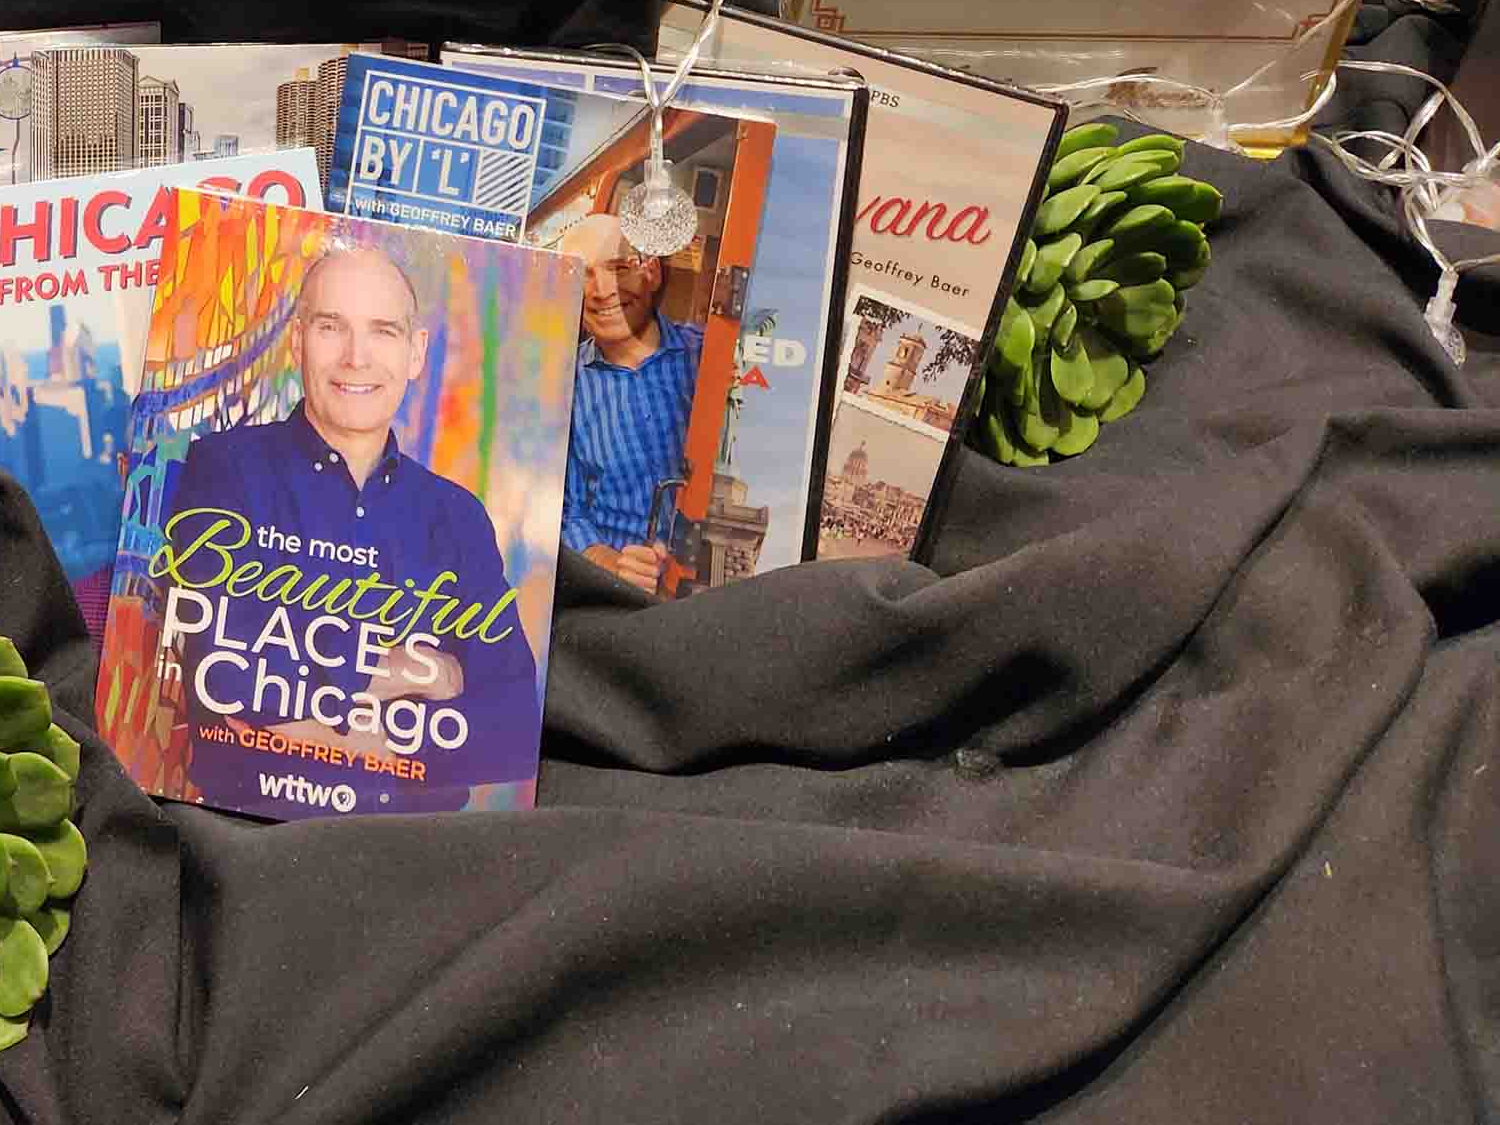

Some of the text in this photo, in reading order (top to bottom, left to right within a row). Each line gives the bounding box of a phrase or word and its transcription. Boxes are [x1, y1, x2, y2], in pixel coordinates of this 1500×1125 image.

[367, 80, 536, 151] CHICAGO
[872, 90, 901, 109] PBS
[359, 134, 413, 186] BY
[355, 198, 517, 239] with GEOFFREY BAER
[97, 258, 161, 293] THE
[850, 251, 971, 298] Geoffrey Baer
[256, 524, 380, 569] the most
[148, 507, 518, 649] Beautiful
[161, 586, 442, 686] PLACES
[156, 651, 470, 754] in Chicago
[199, 725, 428, 781] with GEOFFREY BAER
